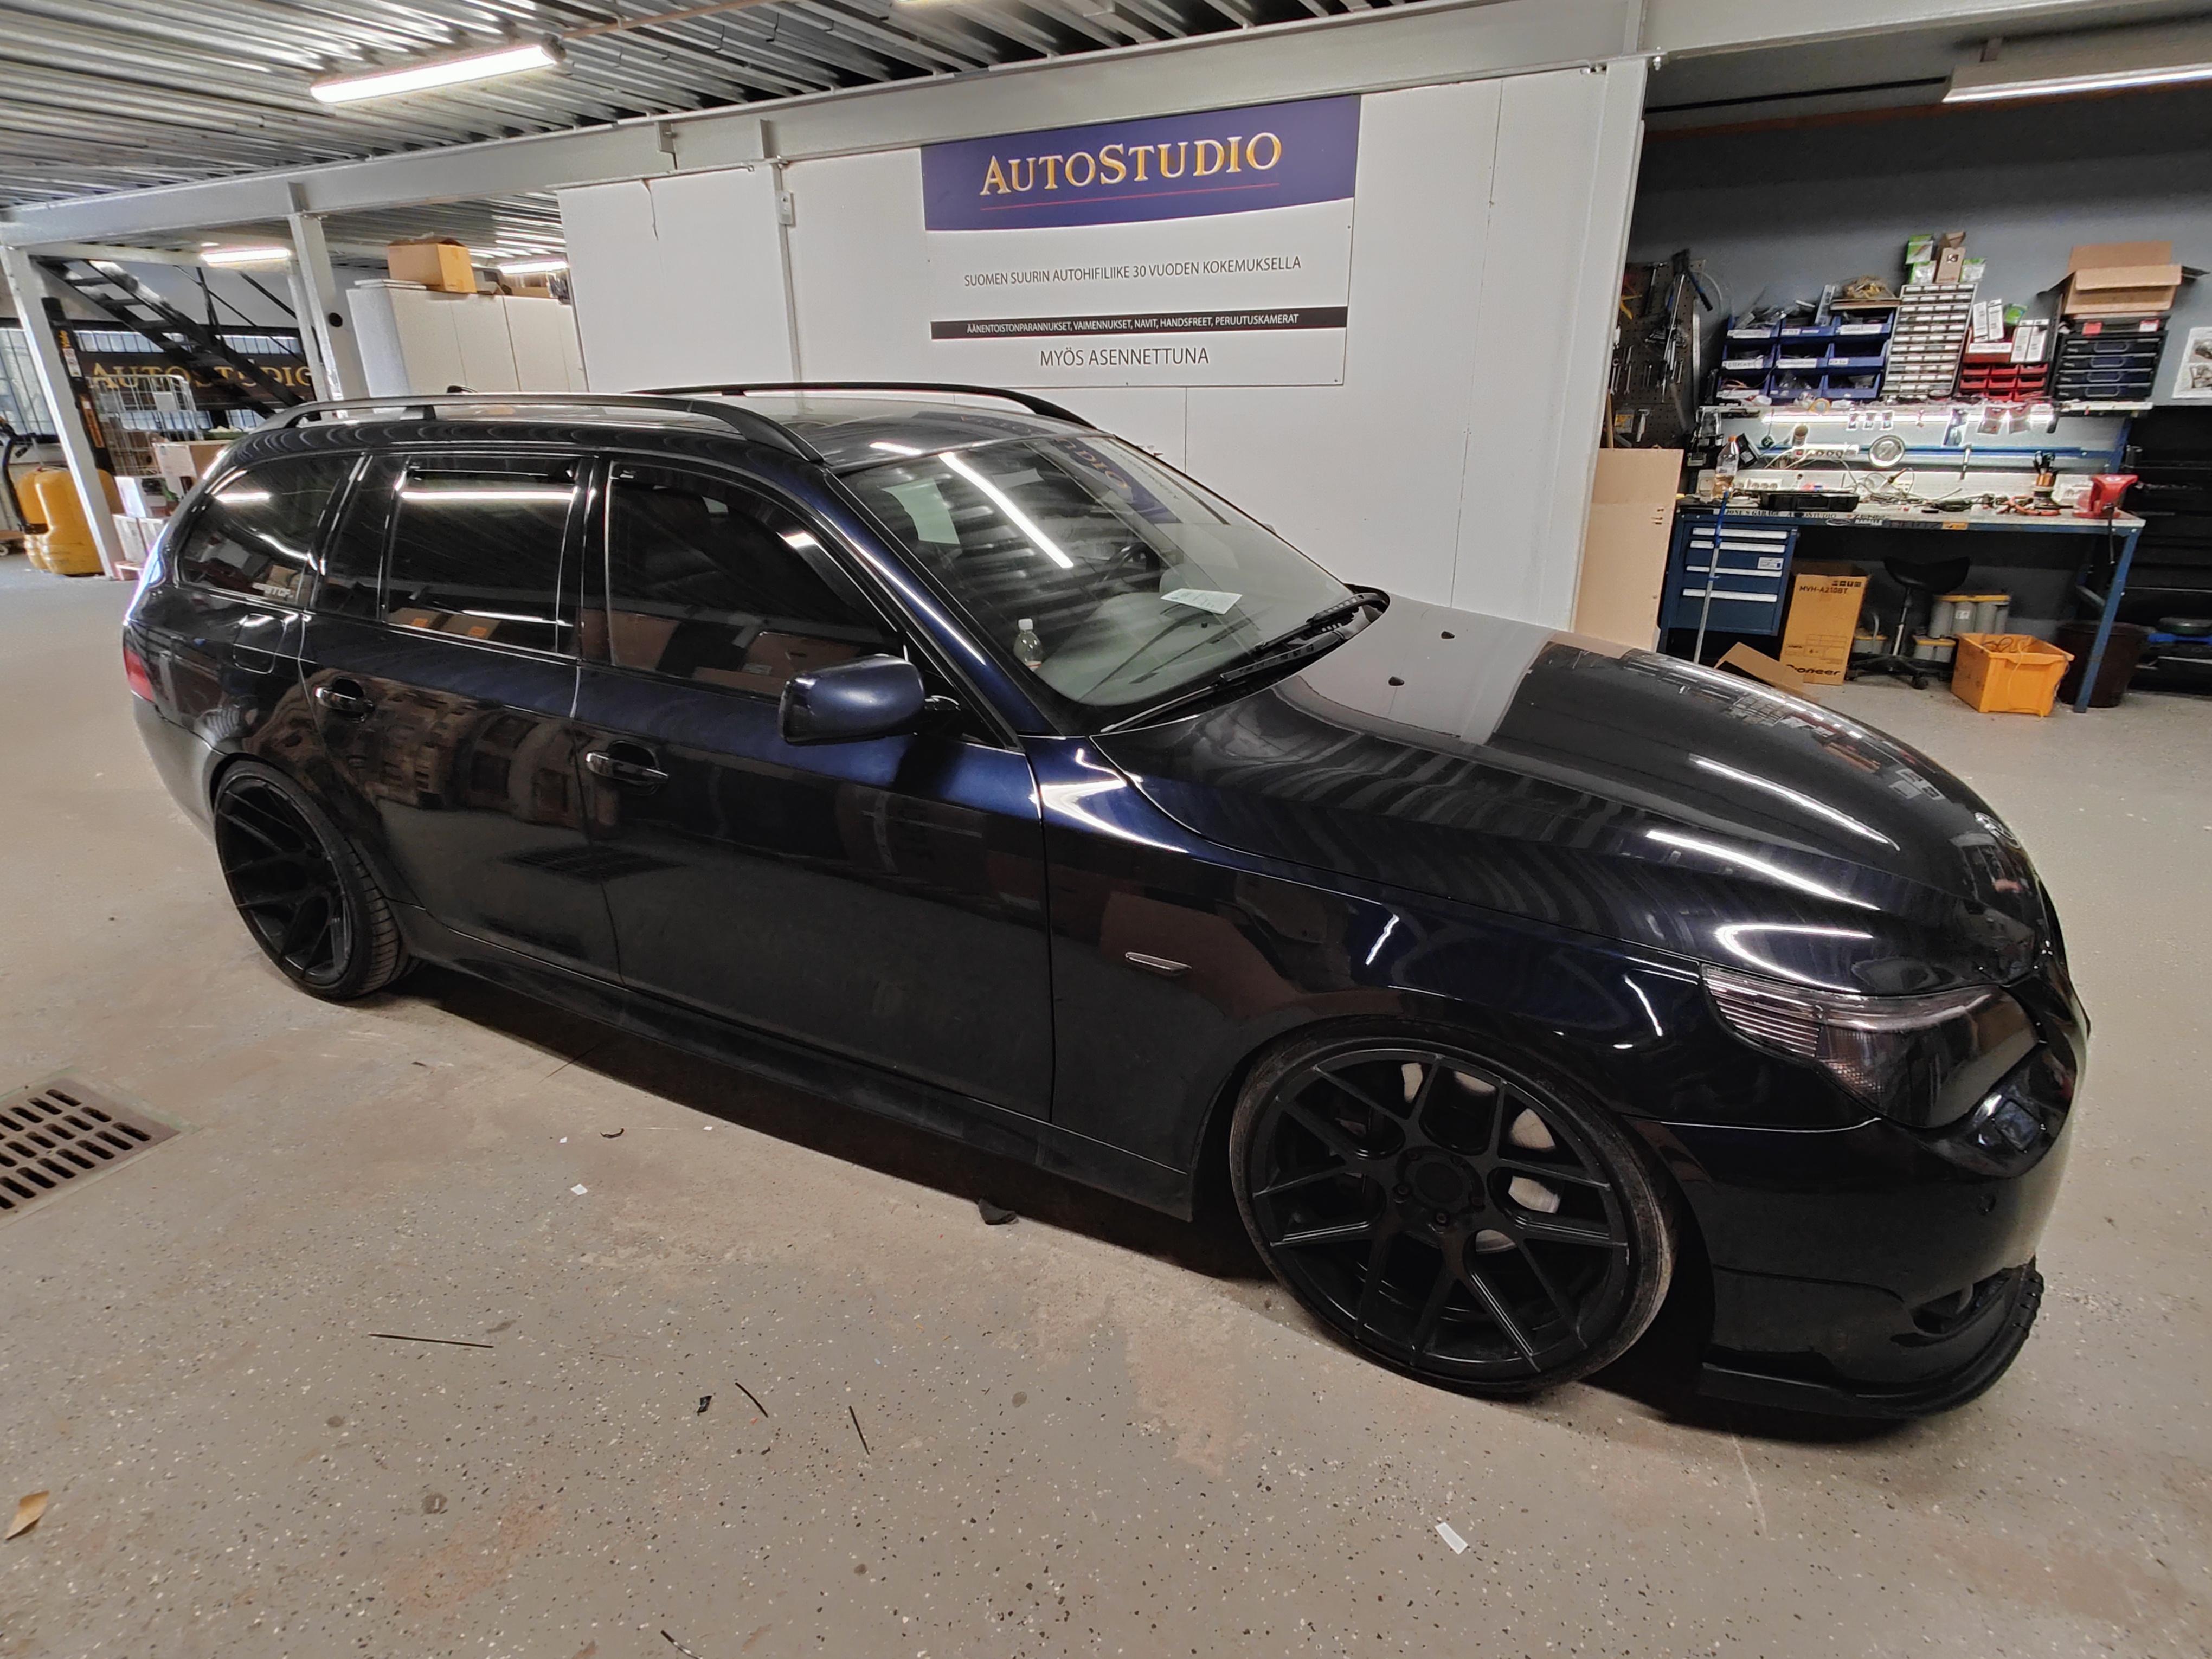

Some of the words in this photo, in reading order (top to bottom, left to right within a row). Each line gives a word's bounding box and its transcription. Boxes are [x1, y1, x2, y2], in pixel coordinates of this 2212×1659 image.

[979, 132, 1282, 196] AUTOSTUDIO
[964, 272, 1008, 287] SUOMEN
[1011, 270, 1050, 284] SUURIN
[1052, 265, 1130, 282] AUTOHIFILIIKE
[1133, 265, 1147, 278] 30
[1148, 261, 1199, 276] VUODEN
[1203, 256, 1301, 274] KOKEMUKSELLA
[966, 321, 1073, 333] ÄÄNENTOISTONPARANNUKSET,
[1073, 319, 1133, 331] VAIMENNUKSET,
[1134, 318, 1159, 329] NAVIT,
[1160, 316, 1214, 327] HANDSFREET,
[1215, 313, 1299, 325] PERUUTUSKAMERAT
[1040, 347, 1084, 366] MYÖS
[1088, 347, 1209, 366] ASENNETTUNA
[1786, 664, 1841, 676] oneer
